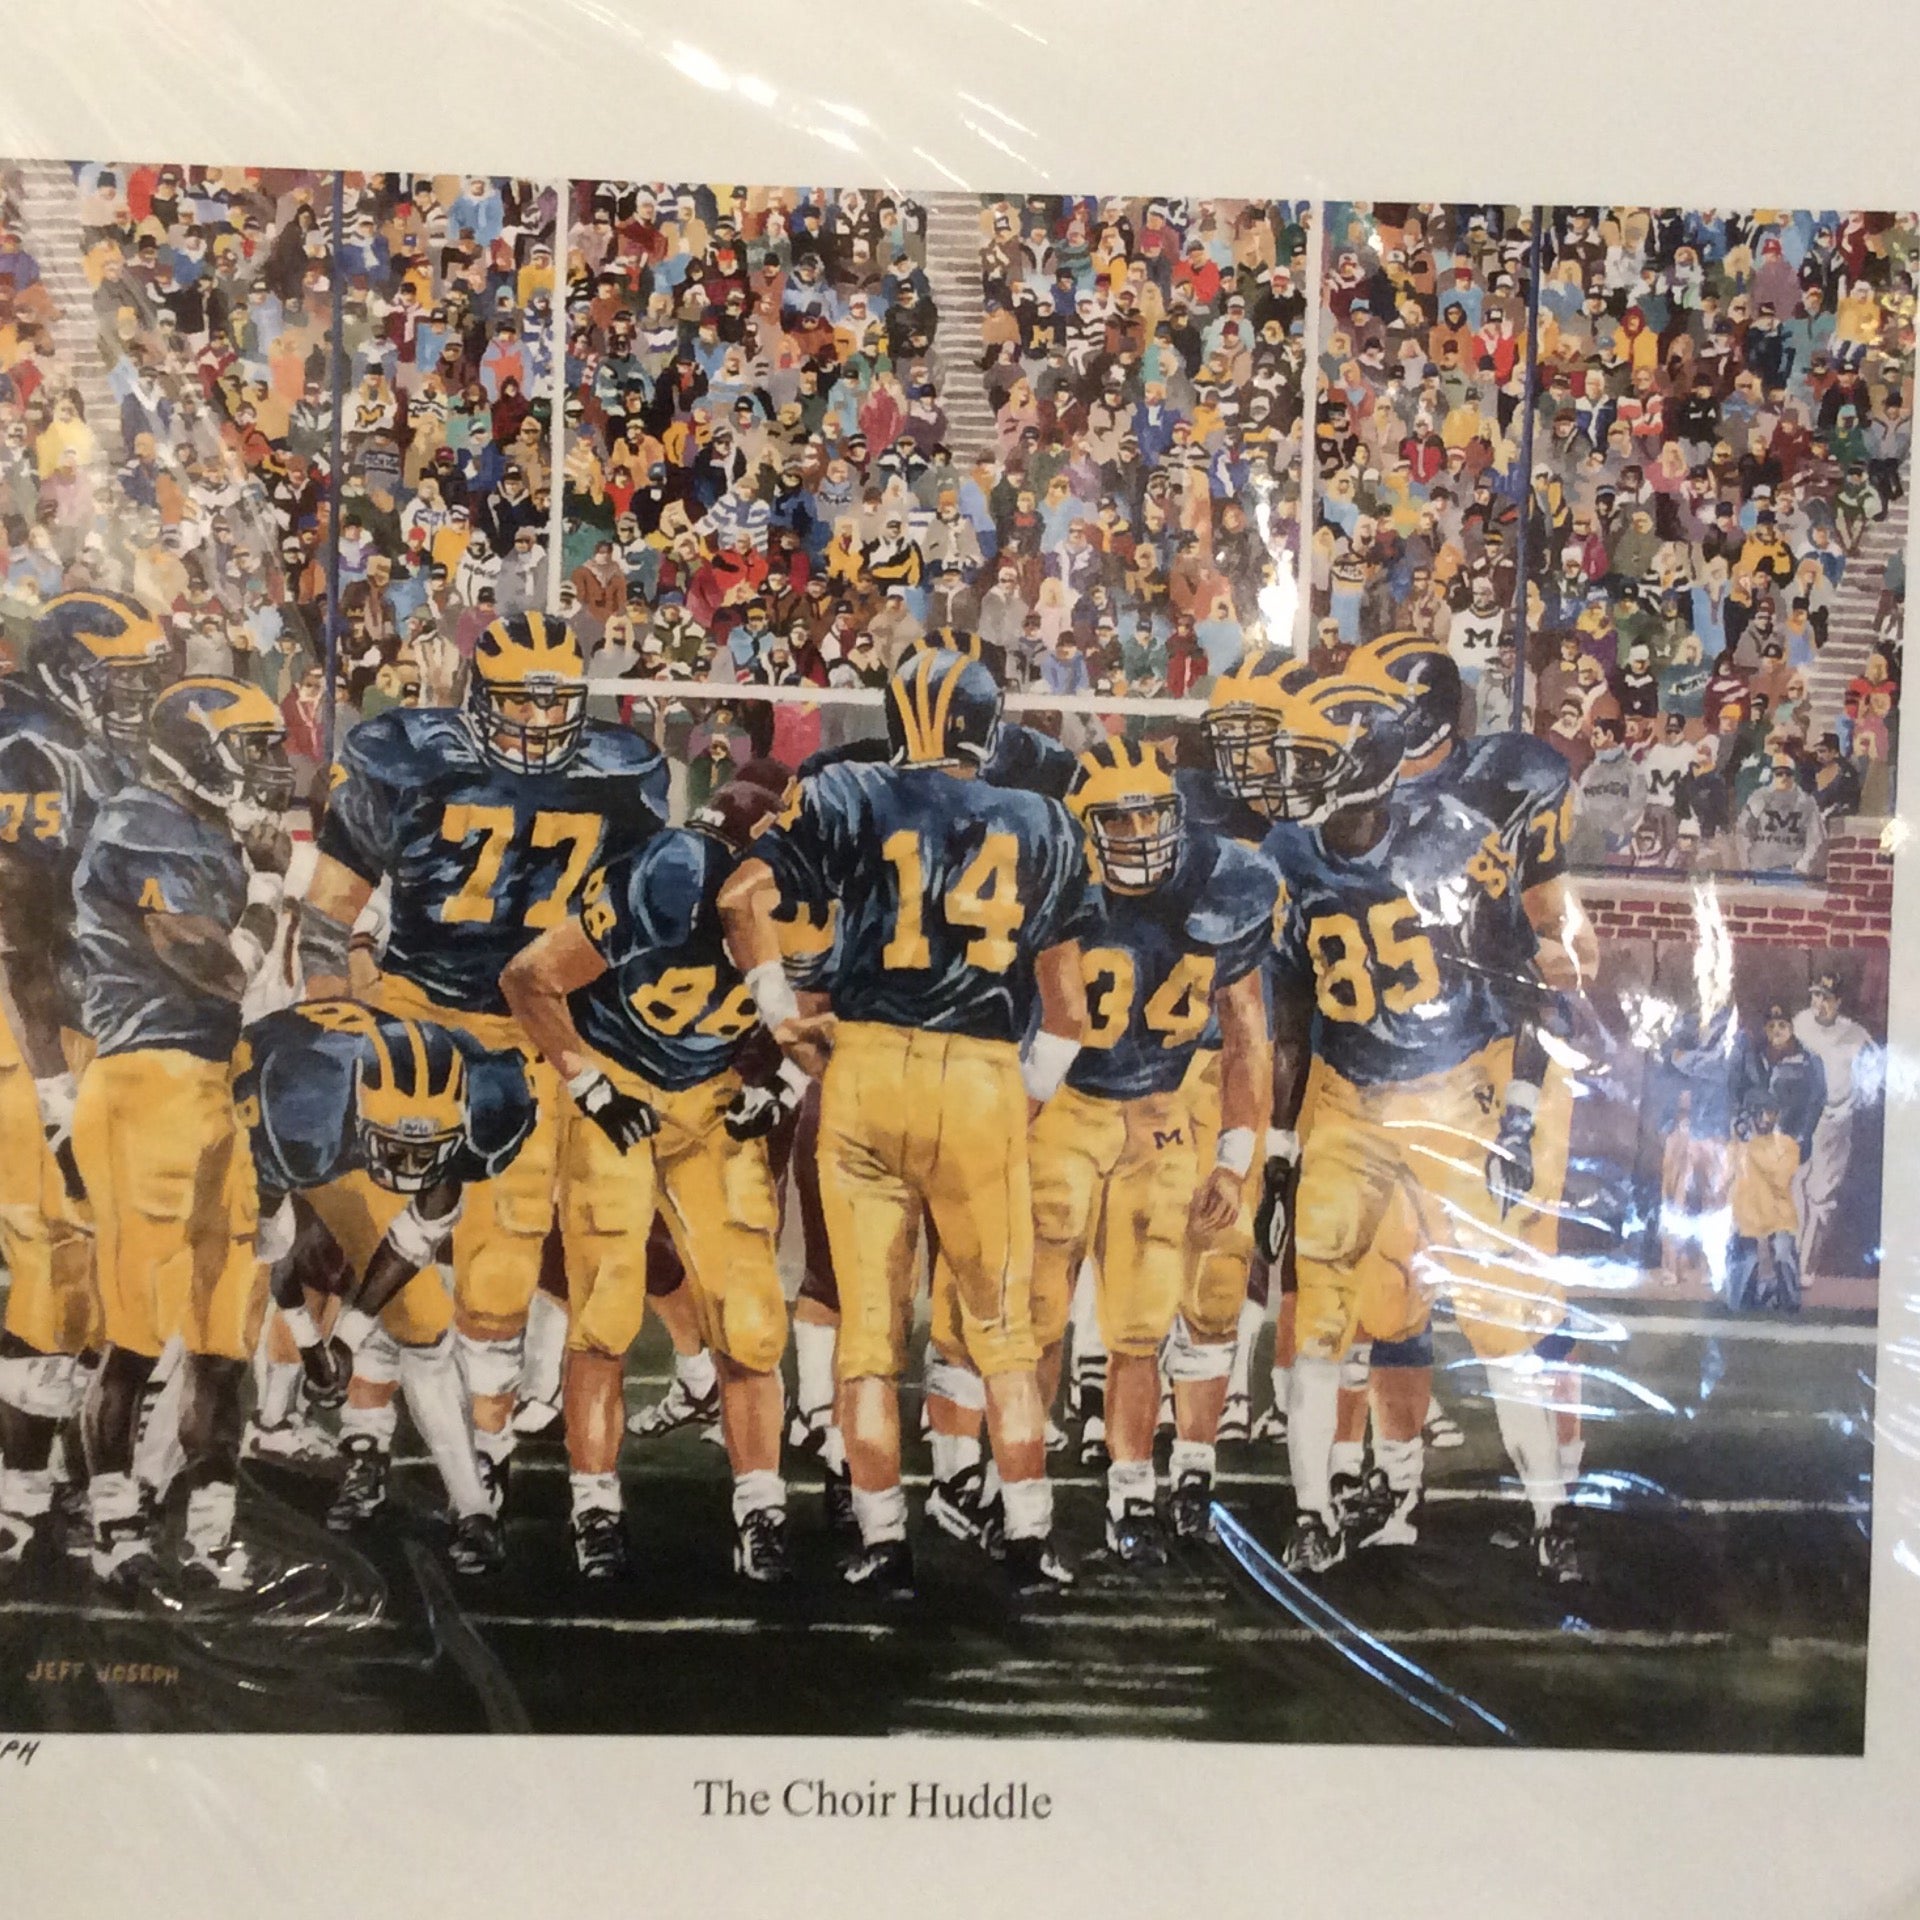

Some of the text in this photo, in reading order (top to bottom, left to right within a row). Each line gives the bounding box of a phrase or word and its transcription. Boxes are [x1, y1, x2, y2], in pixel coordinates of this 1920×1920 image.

[1463, 628, 1494, 648] M
[1650, 769, 1681, 796] M
[0, 791, 62, 842] 75
[1764, 810, 1803, 834] M
[441, 804, 604, 929] 77
[882, 828, 1024, 973] 14
[1306, 896, 1440, 1025] 85
[1080, 947, 1217, 1050] 34
[1153, 1128, 1184, 1150] M
[26, 1661, 180, 1685] JEFF JOSEPH
[693, 1779, 1053, 1820] The Choir Huddle
